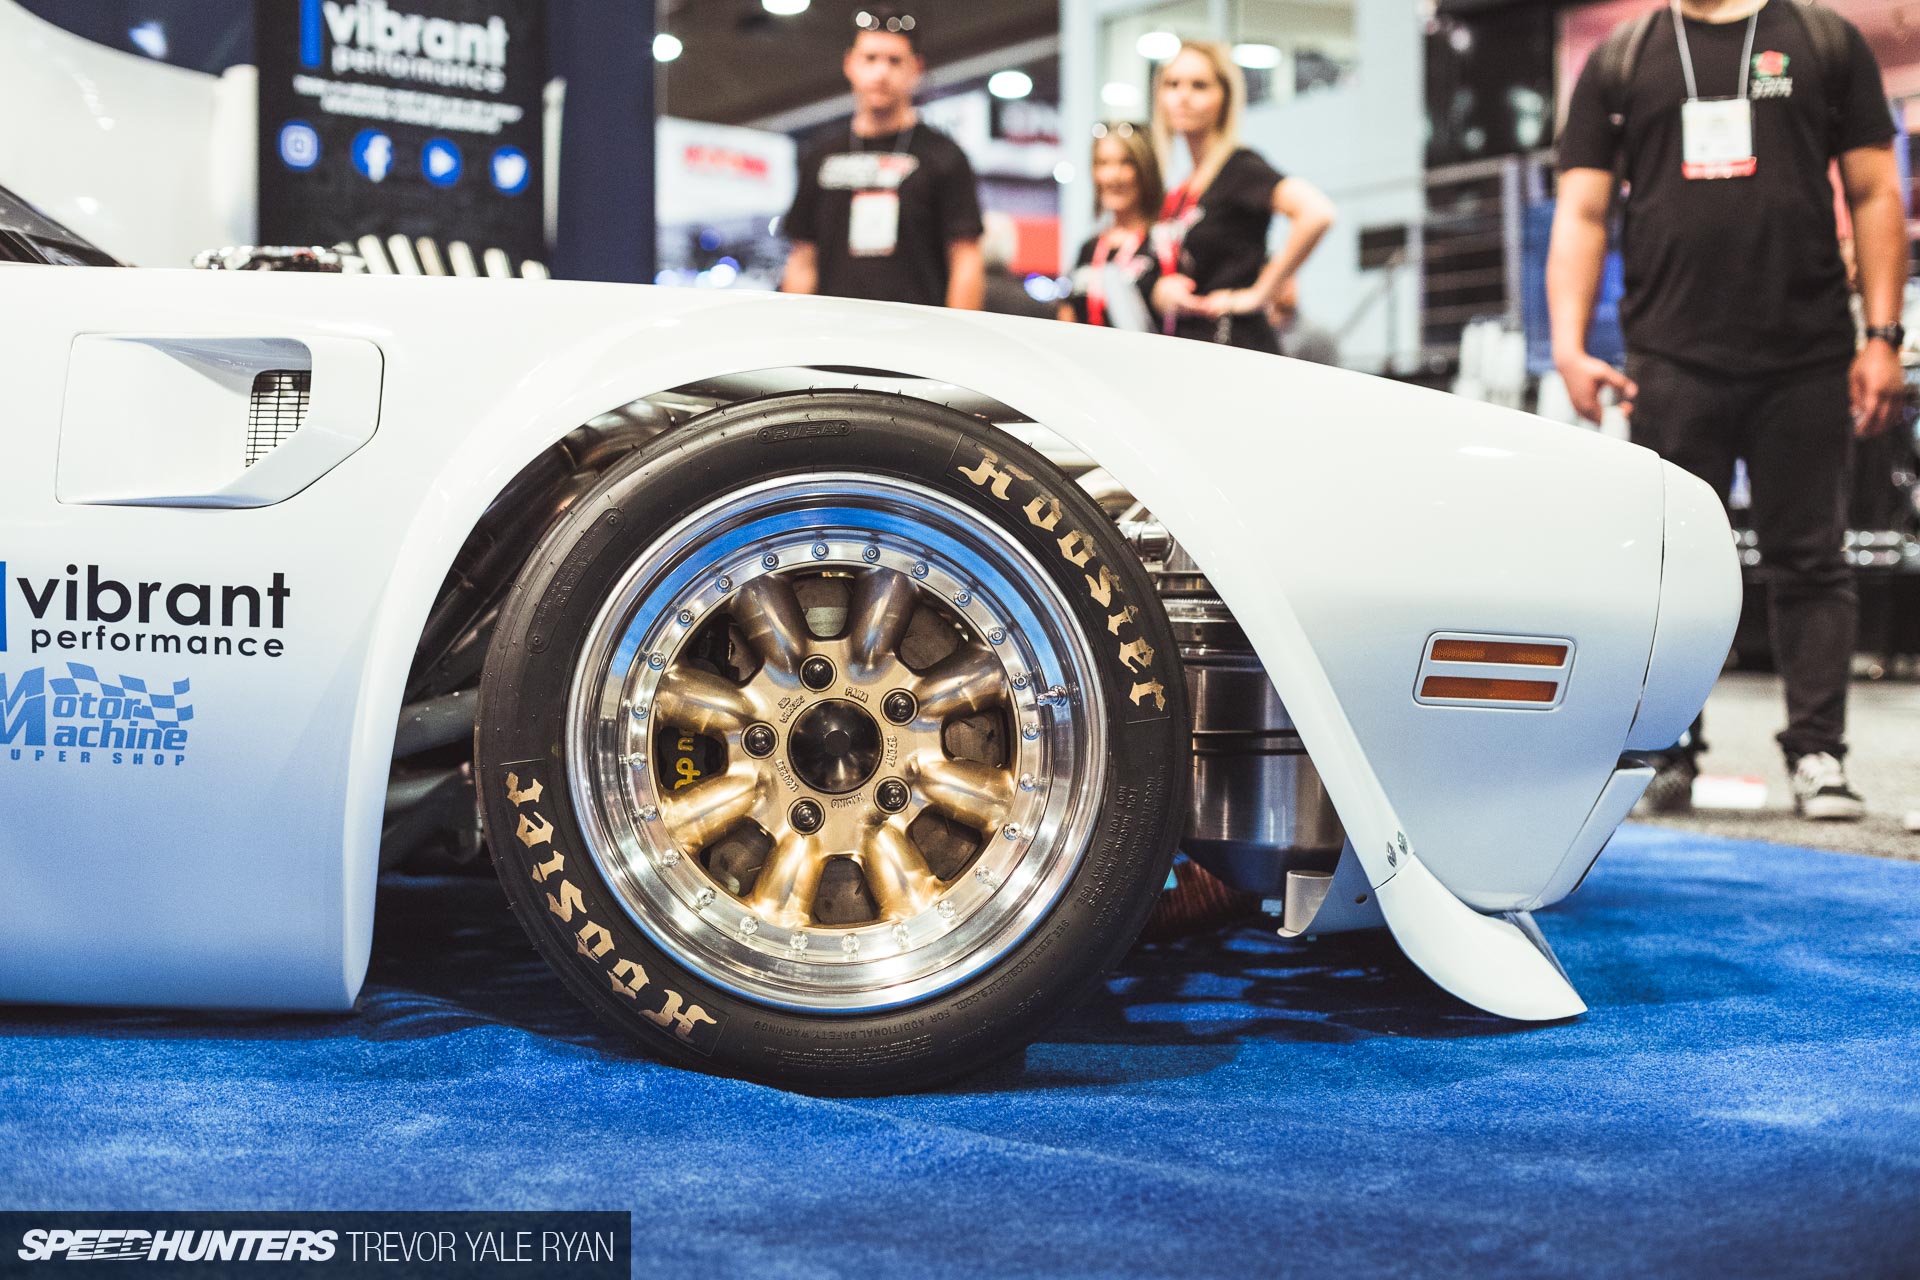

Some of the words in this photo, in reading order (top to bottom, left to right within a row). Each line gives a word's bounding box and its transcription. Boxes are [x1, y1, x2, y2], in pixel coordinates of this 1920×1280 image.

[17, 563, 291, 629] vibrant
[31, 625, 285, 658] performance
[112, 752, 185, 766] SHOP
[1114, 784, 1128, 808] NOT
[1124, 786, 1139, 810] FOR
[1106, 811, 1122, 835] FOR
[1112, 813, 1133, 854] RACING
[1088, 837, 1115, 881] HIGHWAY
[1050, 916, 1071, 939] SEE
[857, 1016, 927, 1039] ADDITIONAL
[928, 1007, 951, 1024] FOR
[751, 1018, 809, 1039] WARNINGS
[812, 1029, 857, 1040] SAFETY
